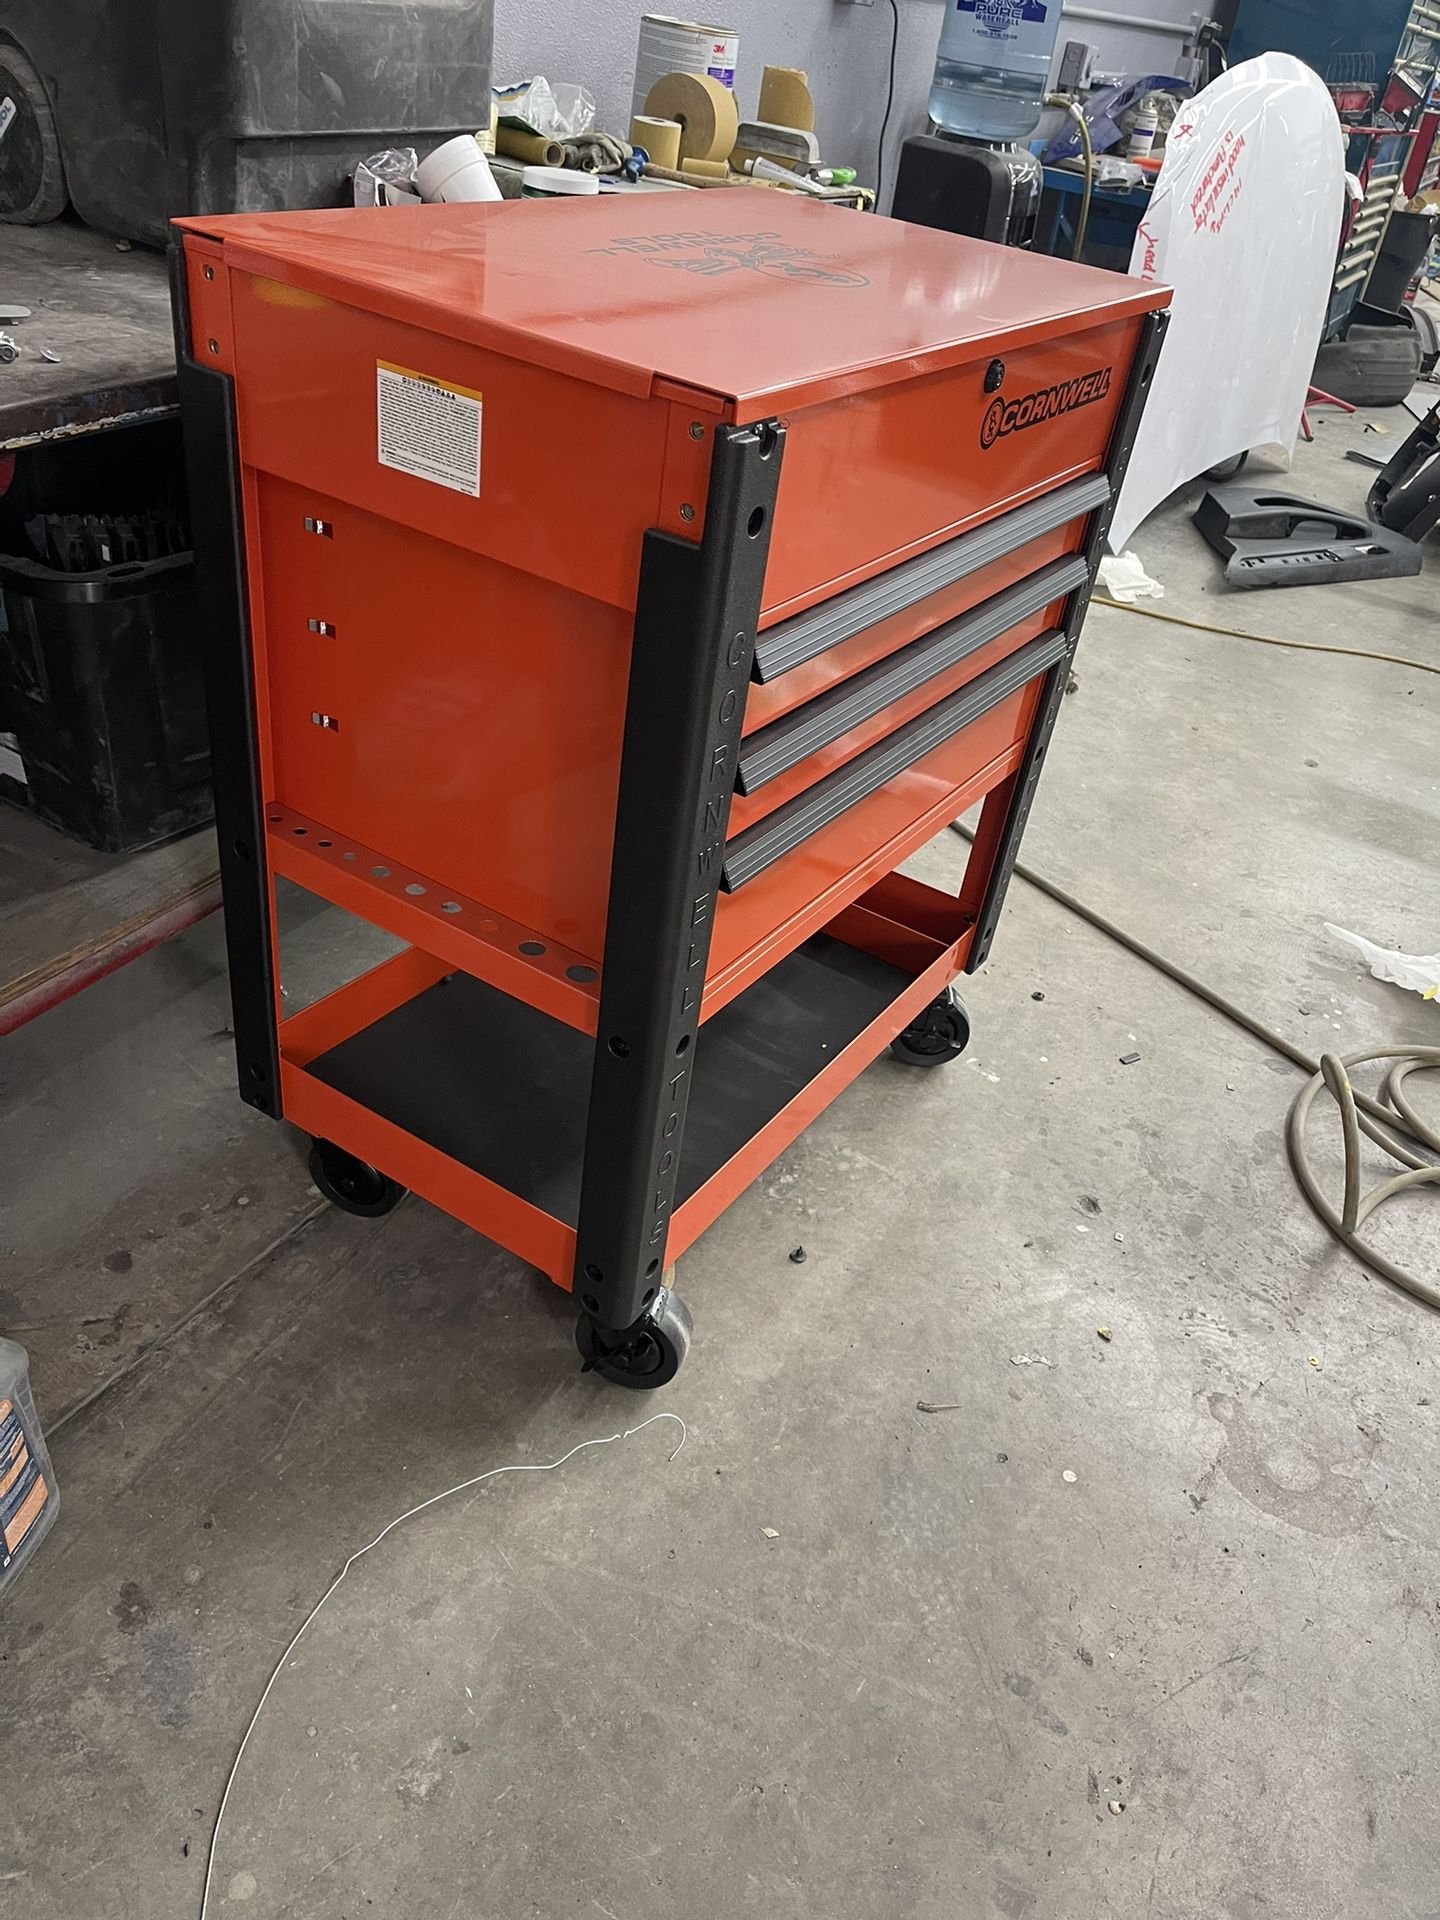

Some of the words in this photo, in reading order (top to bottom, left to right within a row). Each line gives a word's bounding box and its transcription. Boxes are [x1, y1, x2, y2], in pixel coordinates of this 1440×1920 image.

[975, 12, 1019, 26] WATERFALL
[976, 3, 1022, 19] PURE
[713, 44, 726, 54] 3M
[584, 232, 782, 256] CORNWELL
[610, 231, 722, 246] TOOLS
[999, 367, 1113, 437] CORNWELL
[679, 630, 747, 1014] CORNWELL
[648, 1069, 687, 1247] TOOLS
